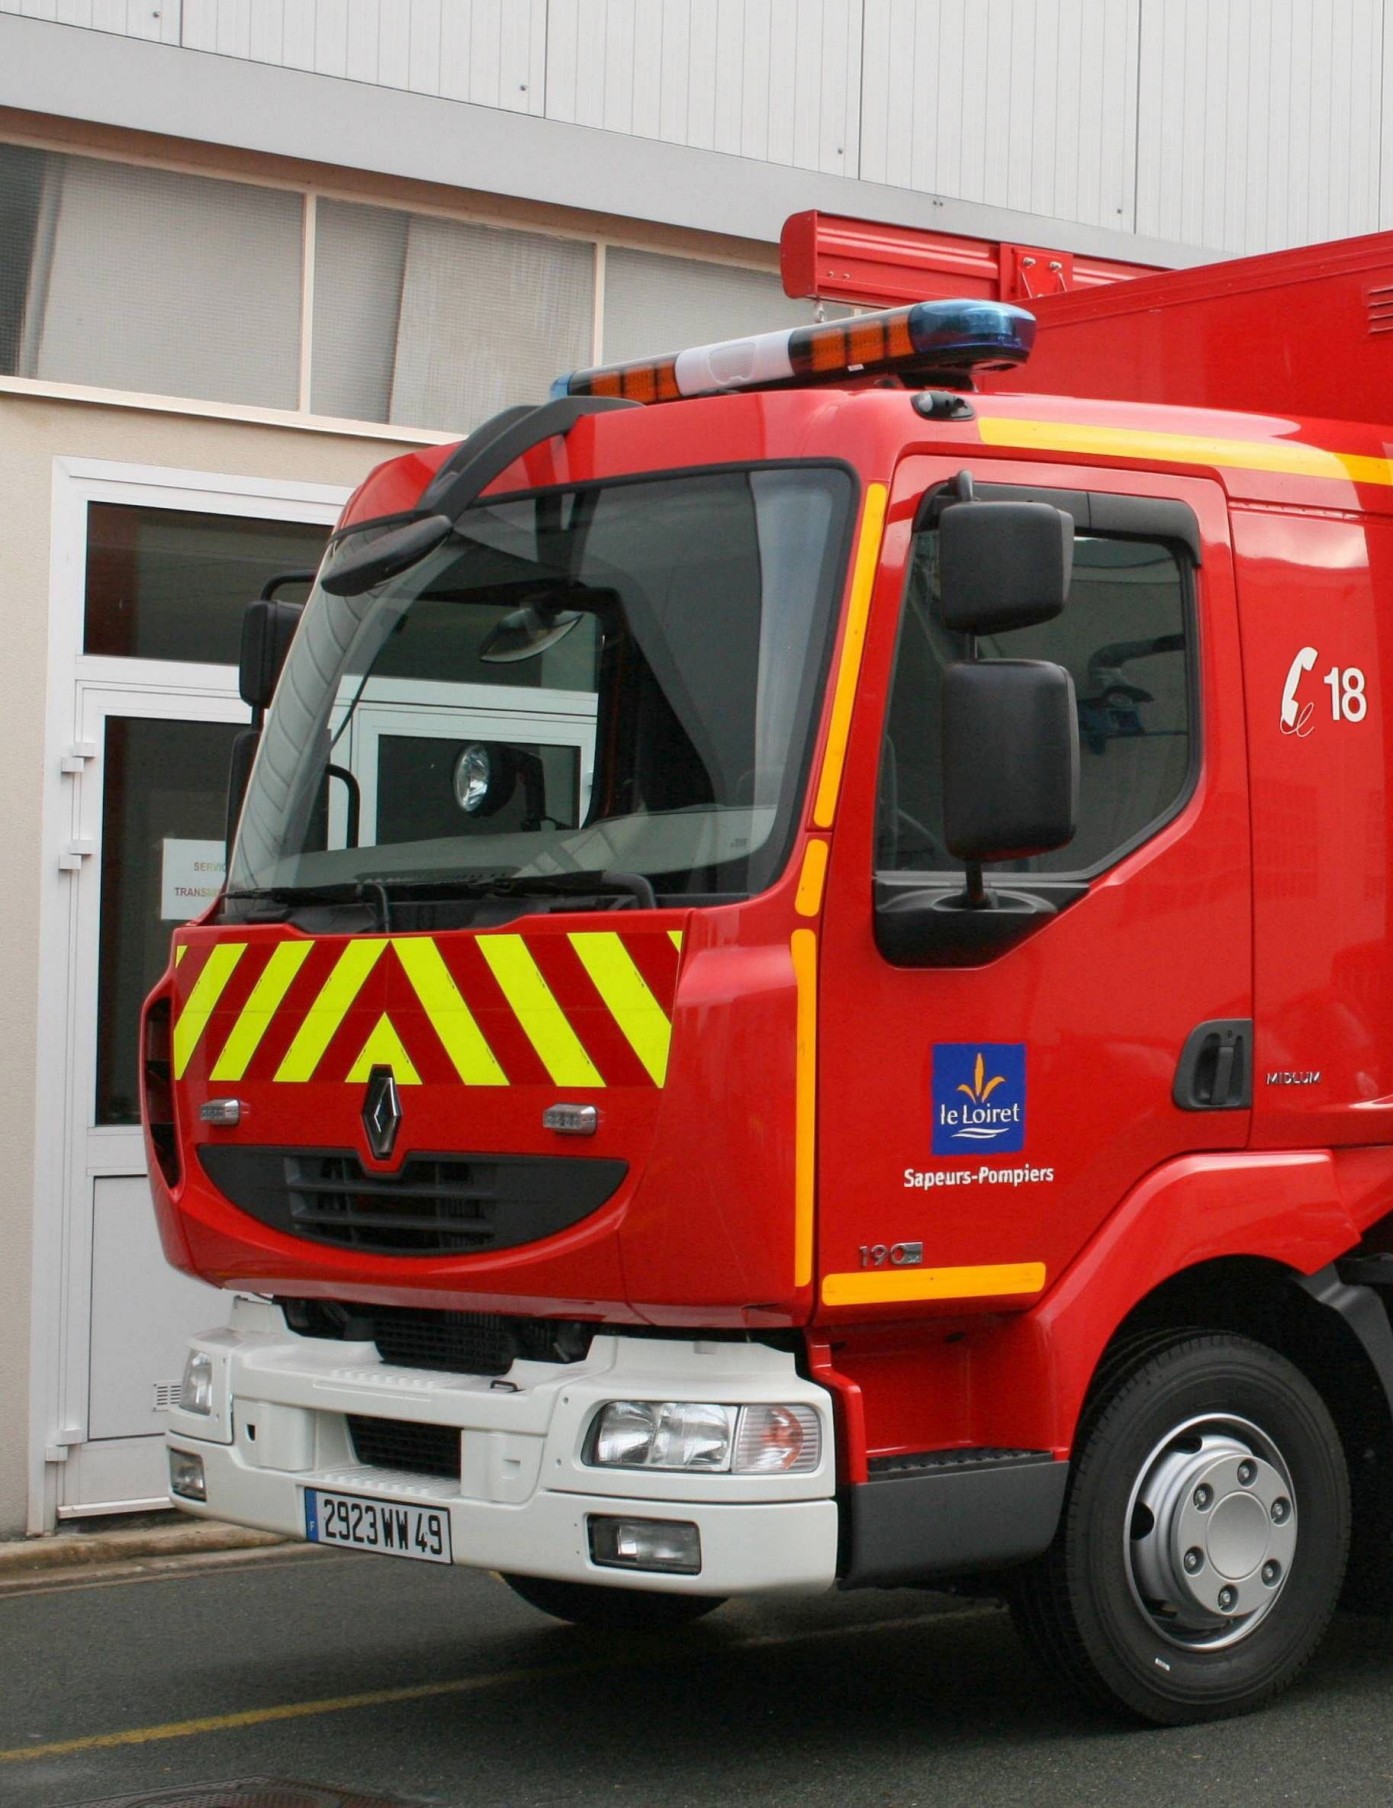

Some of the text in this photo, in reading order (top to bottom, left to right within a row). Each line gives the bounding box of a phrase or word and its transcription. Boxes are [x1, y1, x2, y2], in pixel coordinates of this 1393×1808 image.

[1323, 667, 1367, 722] 18
[1266, 1071, 1321, 1085] MIDLUM
[940, 1102, 1020, 1125] le Loiret
[904, 1164, 1054, 1190] Sapeurs-Pompiers
[859, 1244, 905, 1268] 190
[324, 1499, 443, 1555] 2923 WW 49
